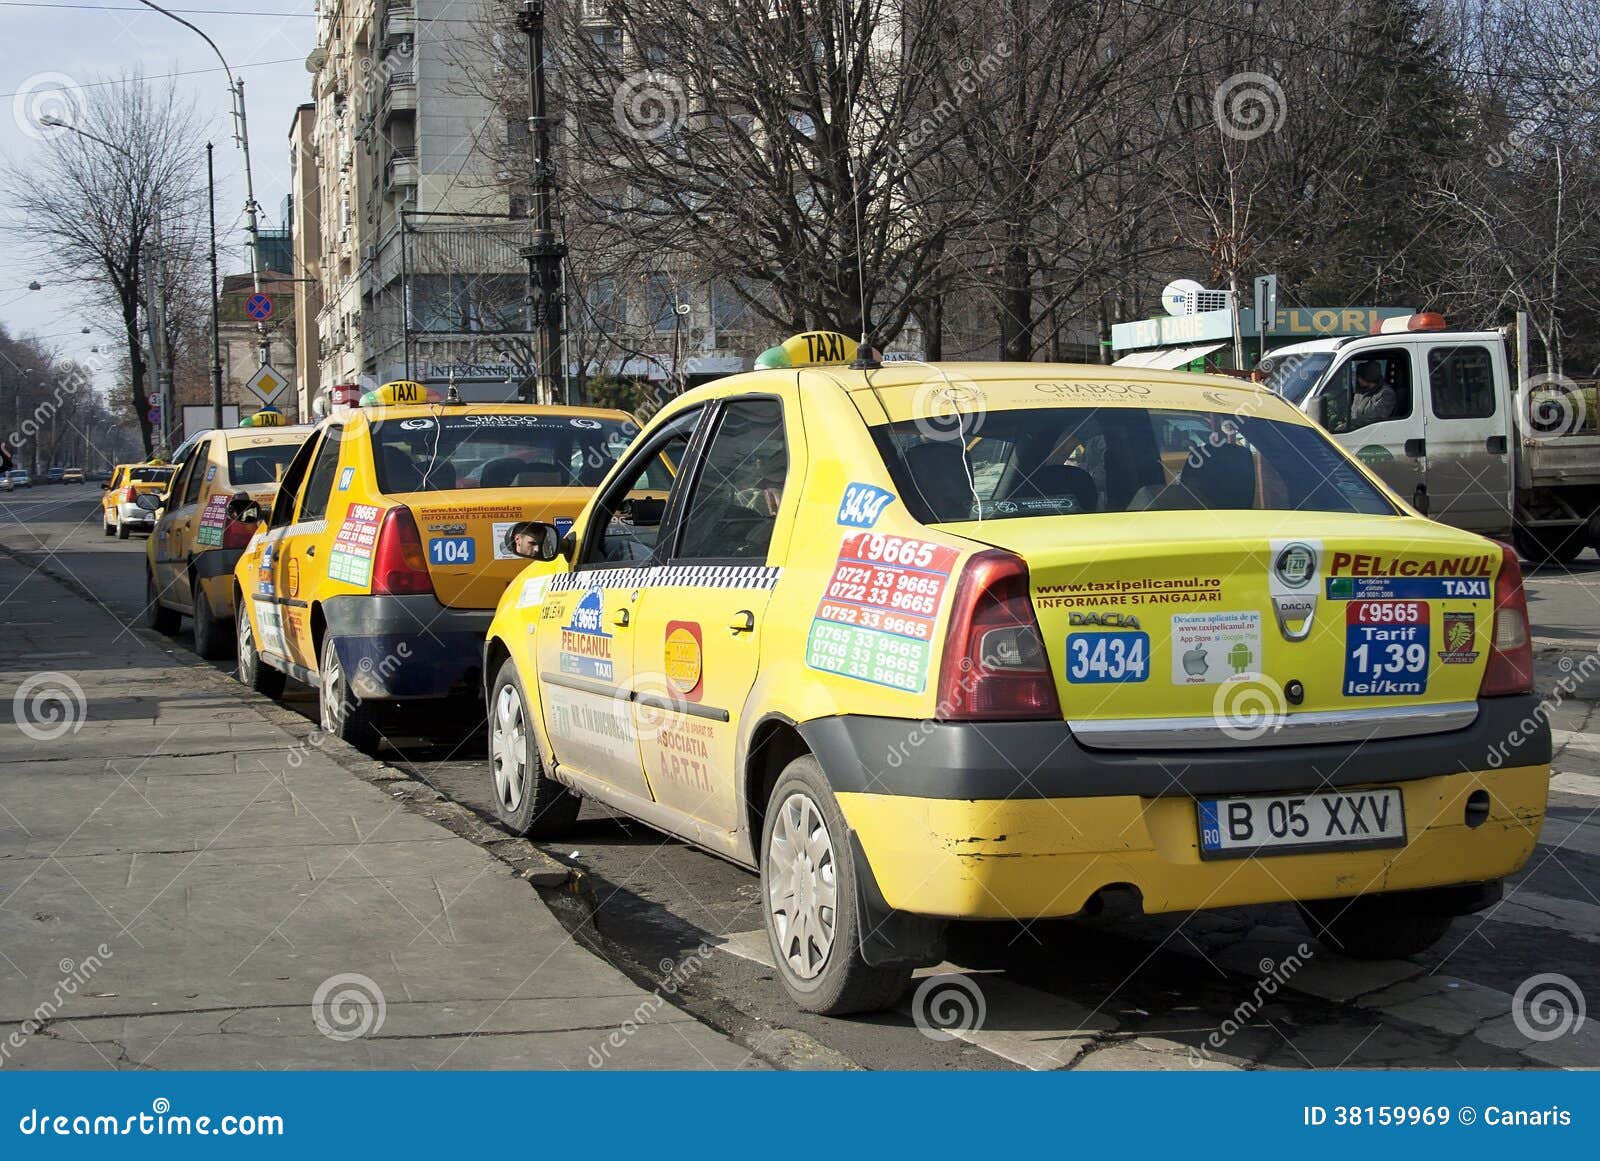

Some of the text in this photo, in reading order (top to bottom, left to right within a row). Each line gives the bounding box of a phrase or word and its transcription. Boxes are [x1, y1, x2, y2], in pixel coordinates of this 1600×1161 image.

[801, 334, 846, 362] TAXI
[390, 383, 417, 401] TAXI
[1034, 383, 1151, 394] CHABOO
[259, 413, 279, 426] TAXI
[840, 487, 889, 524] 3434
[434, 540, 469, 561] 104
[867, 534, 937, 567] 9665
[1331, 552, 1492, 576] PELICANUL
[837, 566, 939, 595] 0721 33 9665
[1037, 577, 1221, 594] www.taxipelicanul.ro
[1442, 580, 1486, 596] TAXI
[829, 582, 866, 601] 0722
[867, 588, 889, 605] 33
[890, 592, 935, 614] 9665
[1037, 592, 1222, 609] INFORMARE SI ANGAJARI
[578, 608, 599, 630] 9665
[822, 605, 857, 623] 0752
[860, 612, 880, 627] 33
[884, 617, 928, 637] 9665
[1069, 612, 1140, 629] DACIA
[1369, 603, 1418, 622] 9565
[561, 631, 611, 659] PELICANUL
[816, 626, 851, 642] 0765
[855, 633, 873, 648] 33
[879, 638, 922, 659] 9665
[1360, 627, 1417, 641] Tarif
[594, 662, 612, 678] TAXI
[851, 647, 871, 662] 33
[876, 652, 919, 673] 9665
[1072, 638, 1144, 678] 3434
[1352, 643, 1426, 680] 1,39
[849, 661, 868, 677] 33
[873, 667, 917, 689] 9665
[1347, 680, 1420, 694] lei/km
[656, 729, 709, 758] ASOCIATIA
[1227, 795, 1390, 841] B 05 XXV
[1204, 829, 1219, 844] RO
